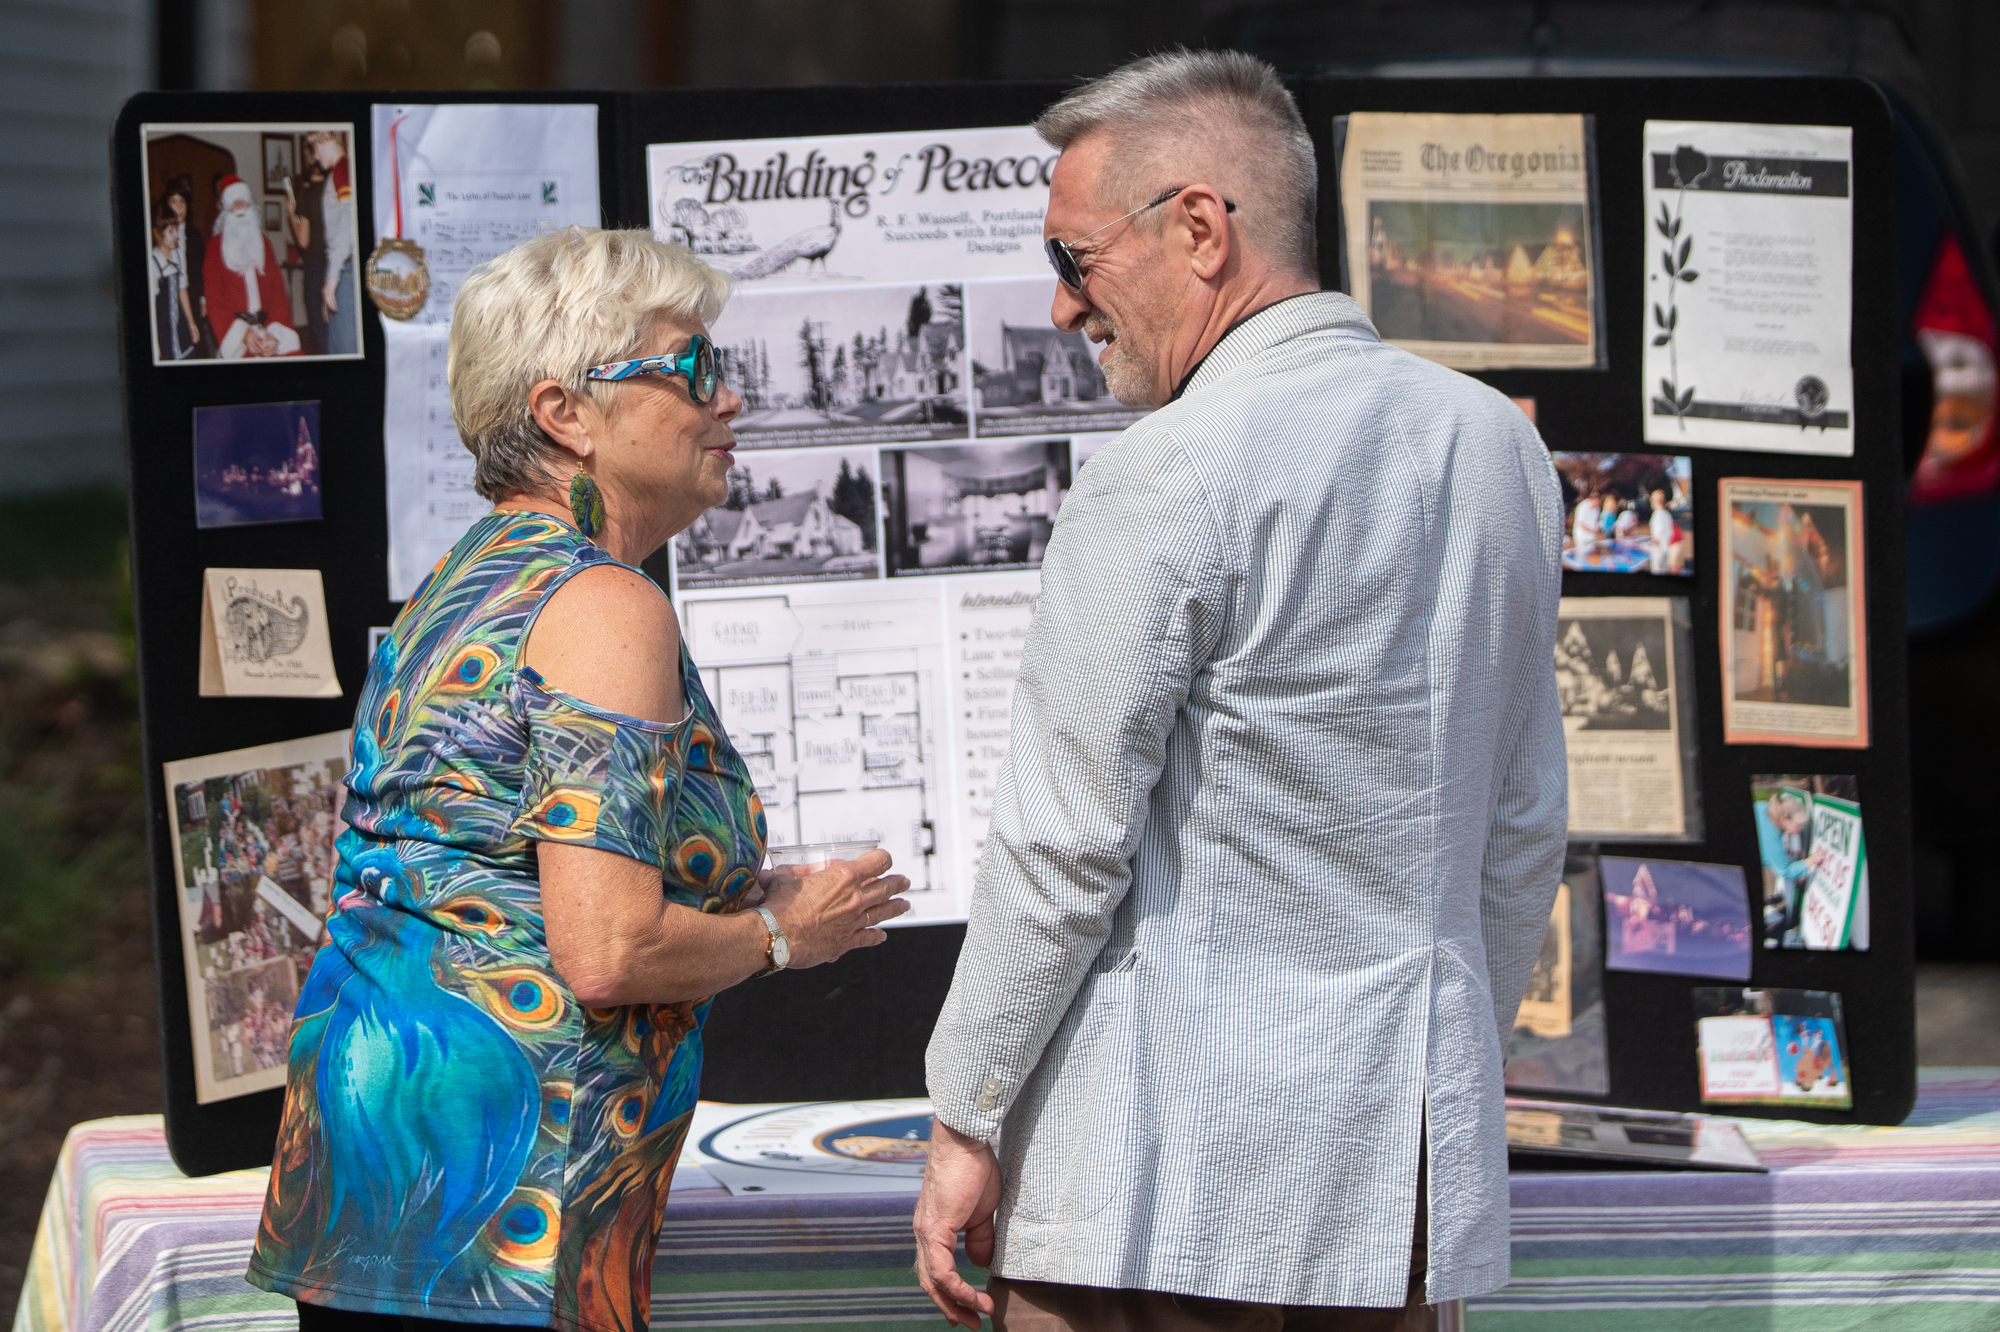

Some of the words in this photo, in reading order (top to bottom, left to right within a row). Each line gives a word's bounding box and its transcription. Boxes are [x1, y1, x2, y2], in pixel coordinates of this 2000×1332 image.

[1419, 142, 1460, 177] The
[1464, 143, 1581, 178] Oregonia
[703, 148, 877, 217] Building
[880, 153, 911, 195] of
[916, 143, 1059, 195] Peacoc
[1722, 160, 1813, 190] Proclamation
[876, 214, 893, 227] R.
[981, 207, 1044, 222] Portland
[884, 228, 948, 243] Succeeds
[953, 225, 986, 238] with
[990, 223, 1043, 238] English
[966, 239, 1022, 254] Designs
[973, 626, 1028, 641] Two-thi
[962, 648, 995, 661] Lane
[976, 666, 1019, 680] Sellin
[977, 706, 1009, 719] First
[979, 745, 1006, 759] The
[967, 765, 987, 779] the
[1817, 809, 1854, 857] OPEN
